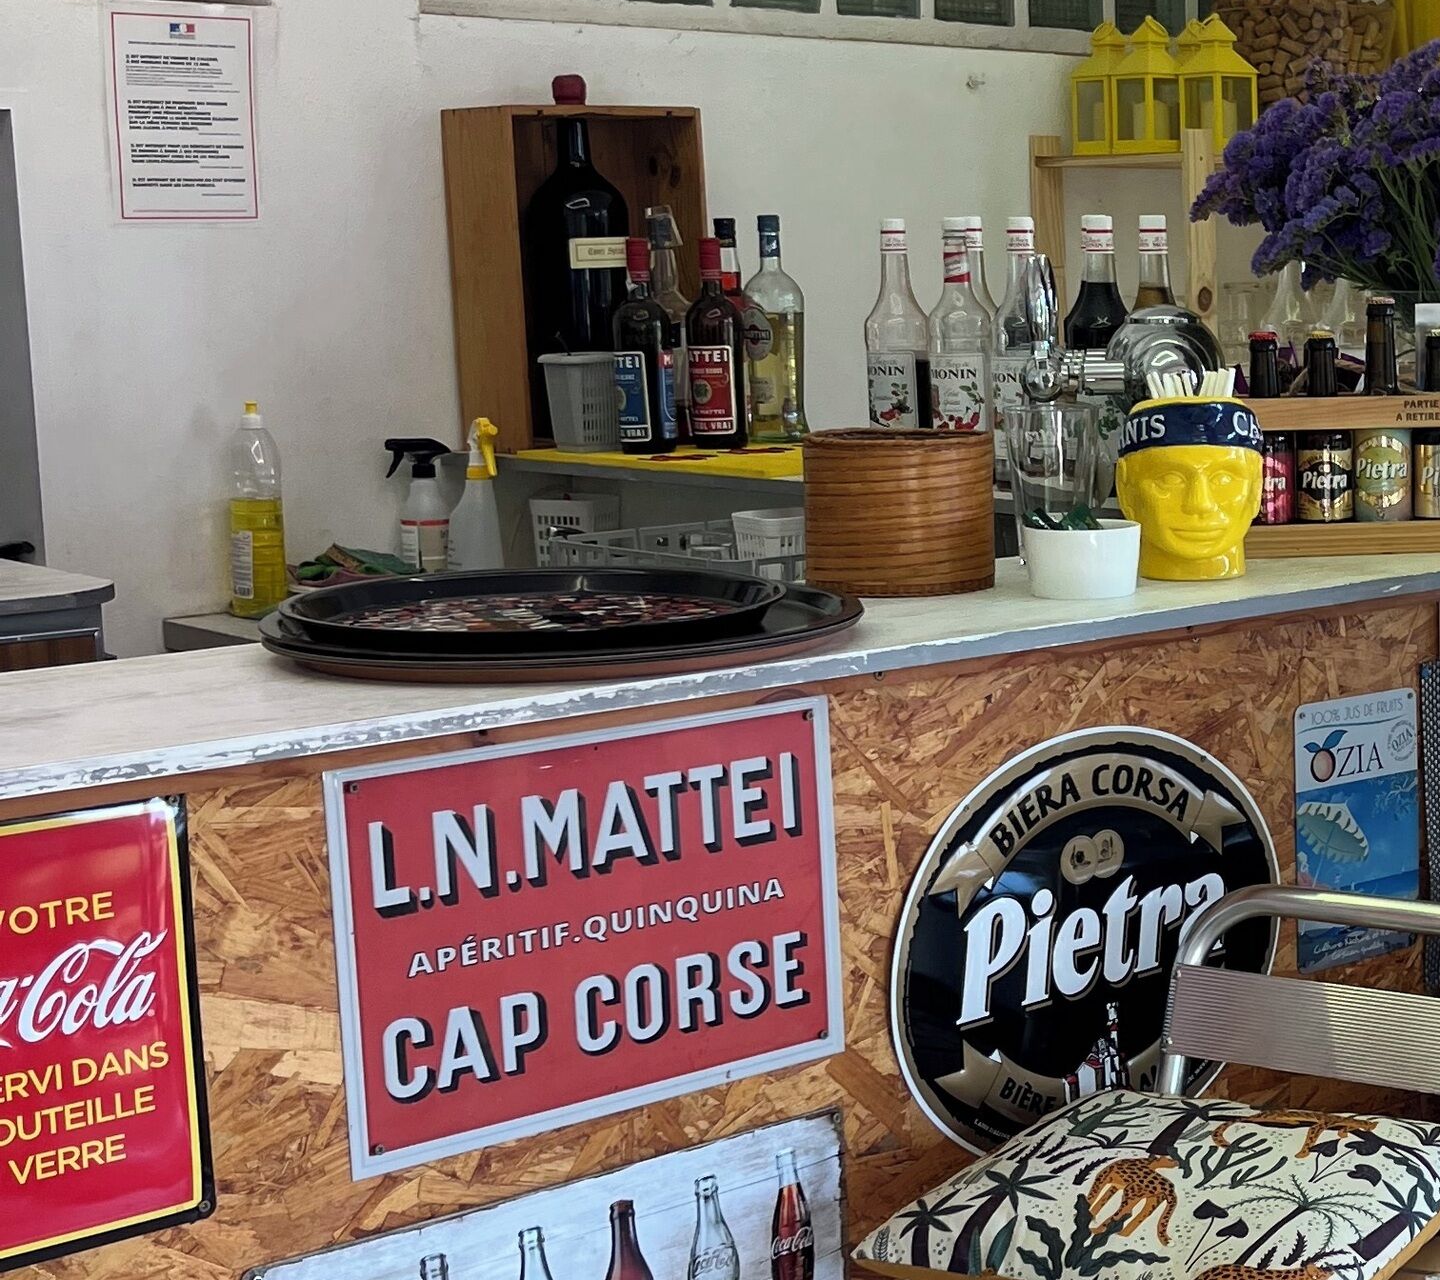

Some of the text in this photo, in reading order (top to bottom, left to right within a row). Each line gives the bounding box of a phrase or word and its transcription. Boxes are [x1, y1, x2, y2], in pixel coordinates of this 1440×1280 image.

[869, 365, 905, 377] ONIN
[1395, 412, 1403, 421] A
[1403, 399, 1440, 409] PARTIE
[1302, 470, 1348, 490] Pietra
[1356, 457, 1408, 481] Pietra
[1311, 708, 1340, 726] 100%
[1343, 704, 1361, 721] JUS
[1363, 702, 1375, 717] DE
[989, 763, 1192, 859] BIERA CORSA
[368, 752, 801, 917] L.N.MATTEI
[0, 891, 115, 935] OTRE
[955, 872, 1228, 1028] Pietra
[382, 930, 808, 1105] CAP CORSE
[0, 1040, 169, 1104] RVI DANS
[999, 1075, 1056, 1117] BIÈRE
[8, 1133, 127, 1186] VERRE
